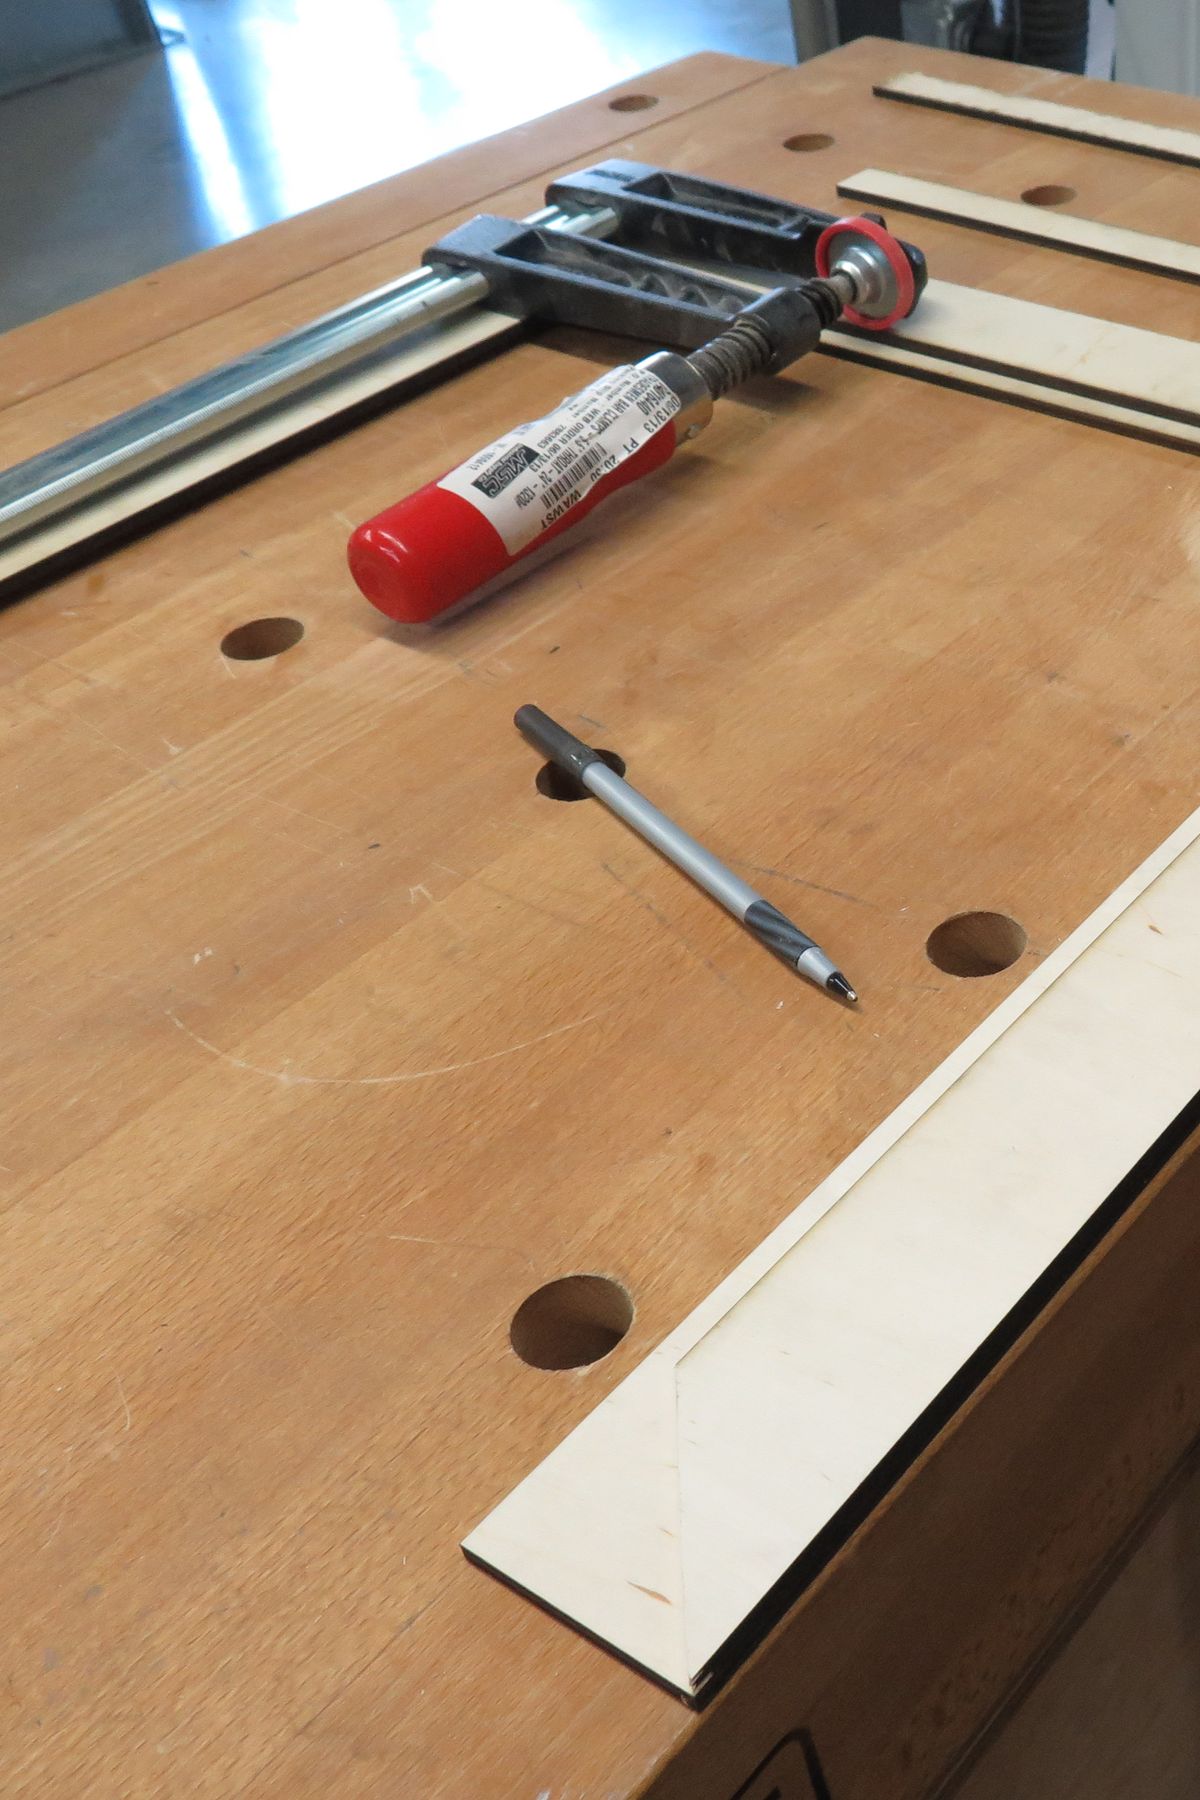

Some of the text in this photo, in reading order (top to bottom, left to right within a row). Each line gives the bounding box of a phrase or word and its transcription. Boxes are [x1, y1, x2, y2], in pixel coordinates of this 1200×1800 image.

[582, 407, 600, 424] WEB
[558, 421, 583, 445] ORDER
[622, 437, 638, 453] PT
[481, 447, 529, 496] MSC
[550, 446, 578, 474] THROAT
[540, 489, 581, 529] WAWST
